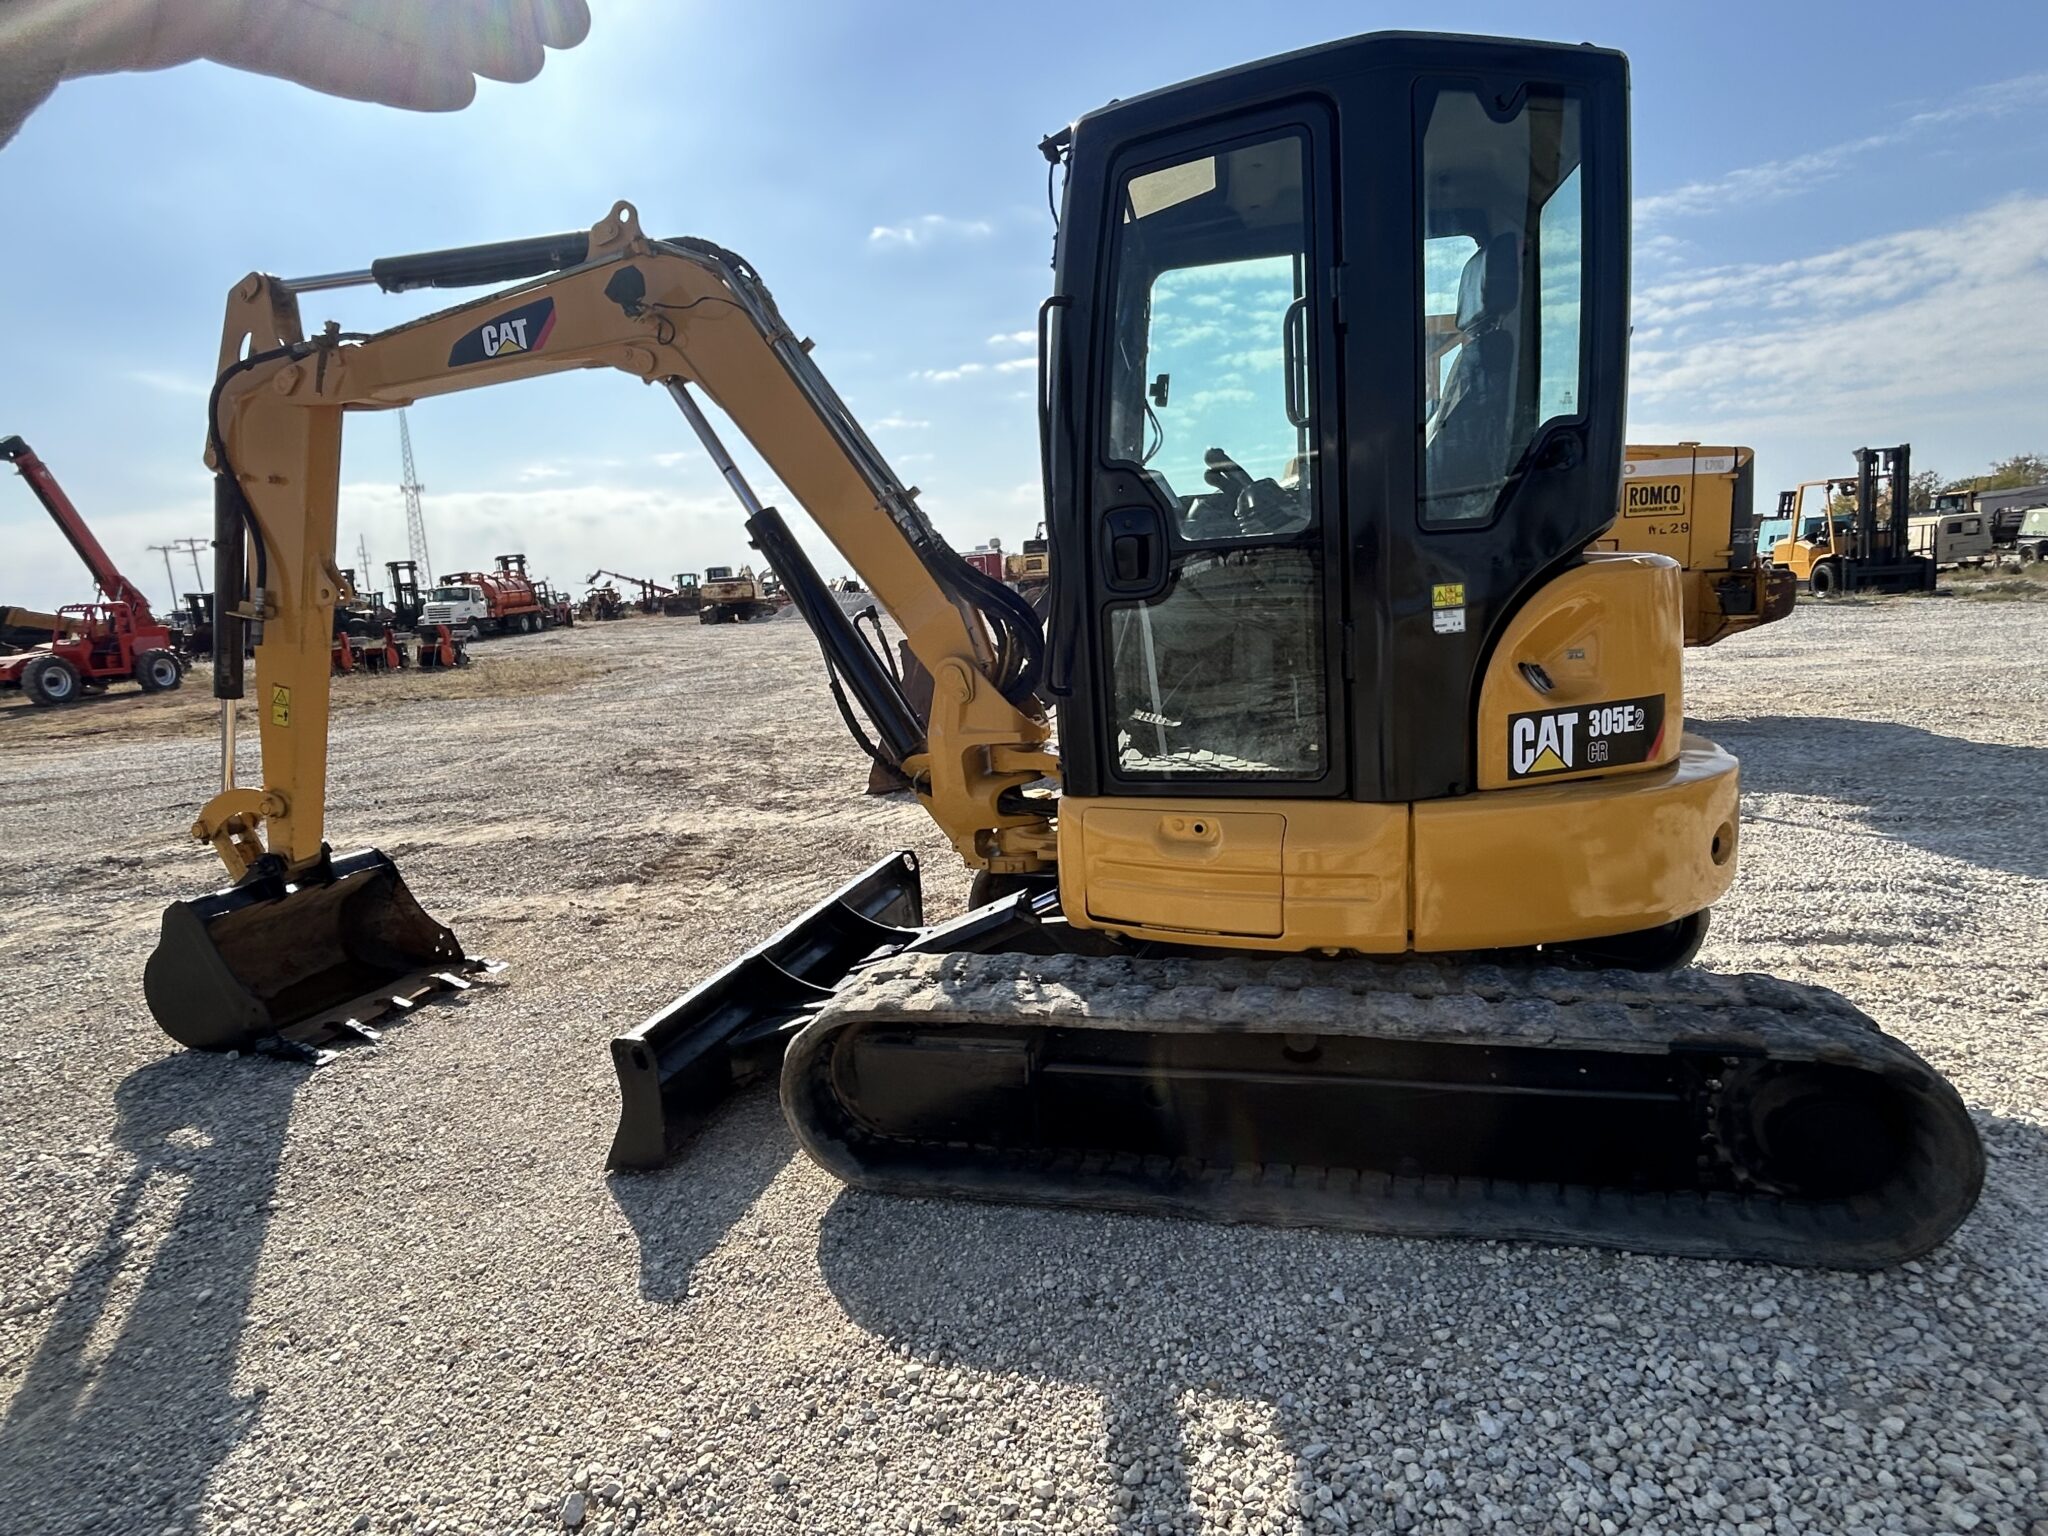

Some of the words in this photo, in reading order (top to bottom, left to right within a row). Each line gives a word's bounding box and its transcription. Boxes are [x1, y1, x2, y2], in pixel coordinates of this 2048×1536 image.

[481, 318, 527, 357] CAT
[1629, 485, 1681, 506] ROMCO
[1513, 712, 1579, 775] CAT
[1588, 705, 1645, 738] 305E2
[1587, 741, 1609, 763] CR
